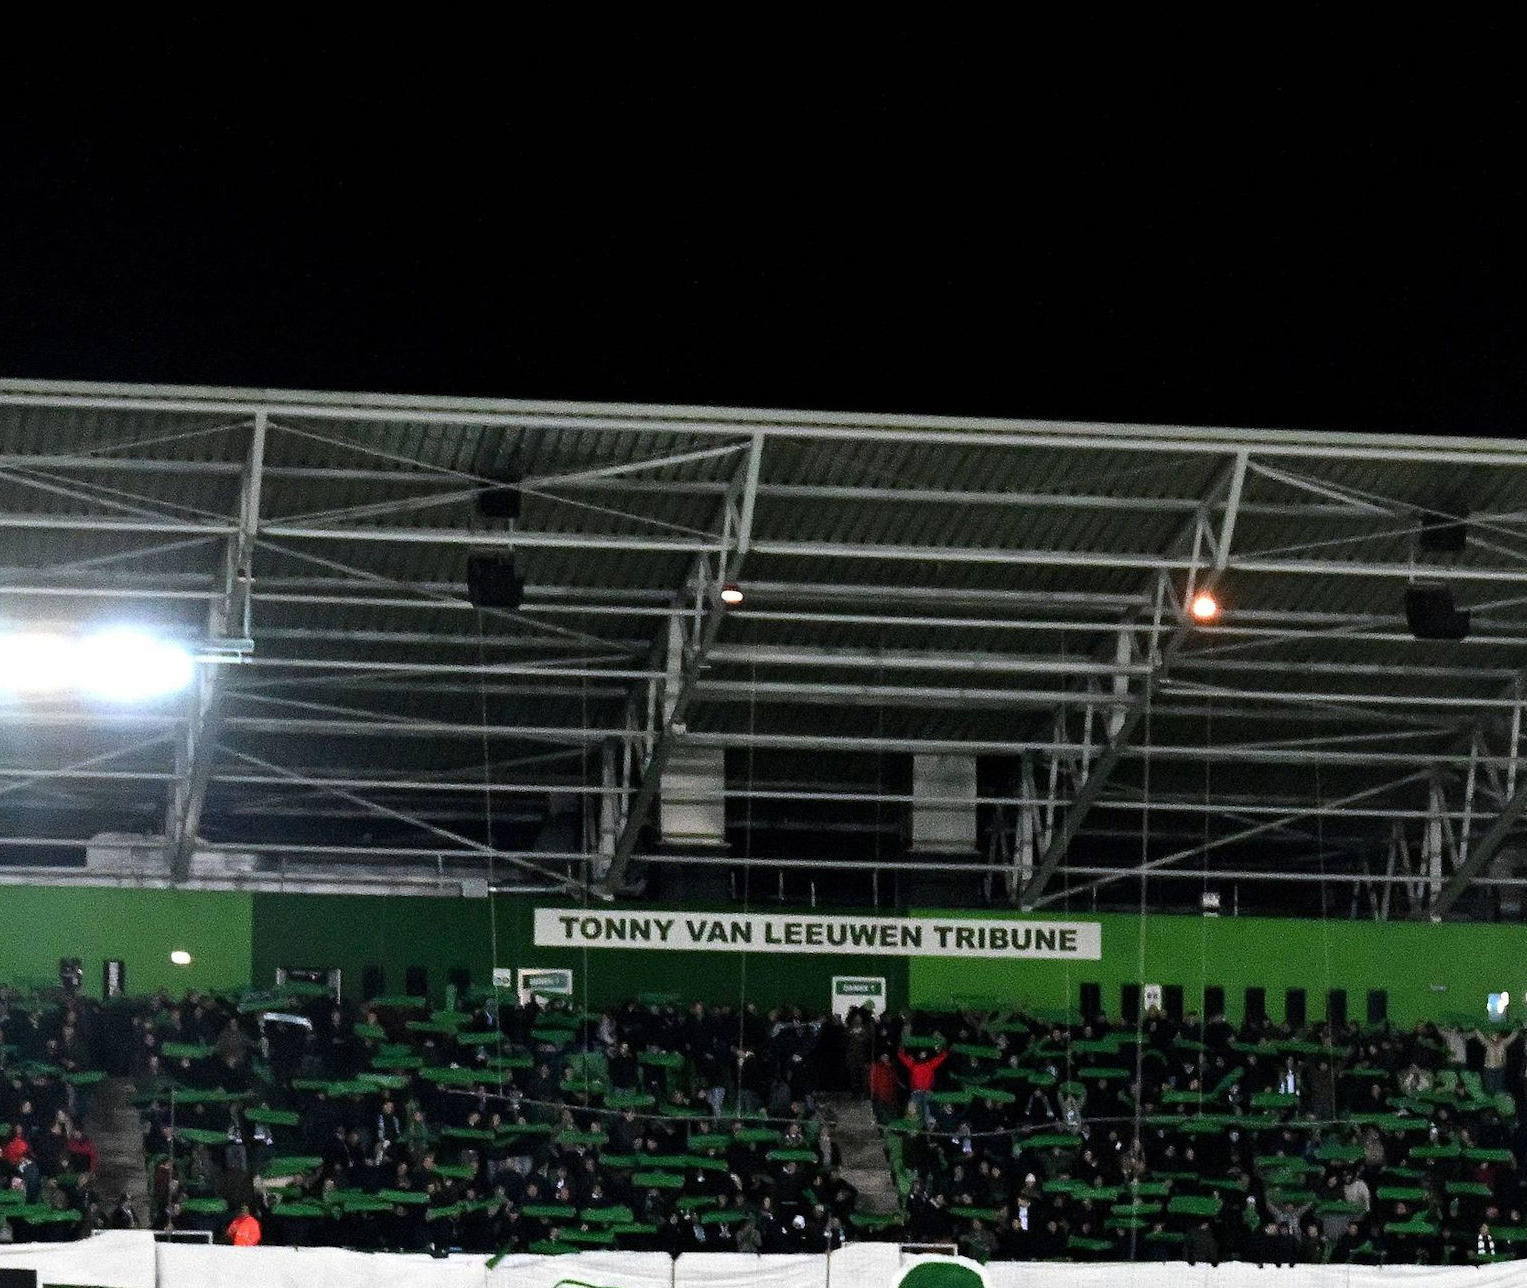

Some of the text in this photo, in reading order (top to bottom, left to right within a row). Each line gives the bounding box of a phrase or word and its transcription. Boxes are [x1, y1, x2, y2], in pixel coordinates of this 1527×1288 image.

[559, 915, 1078, 952] TONNY VAN LEEUWEN TRIBUNE
